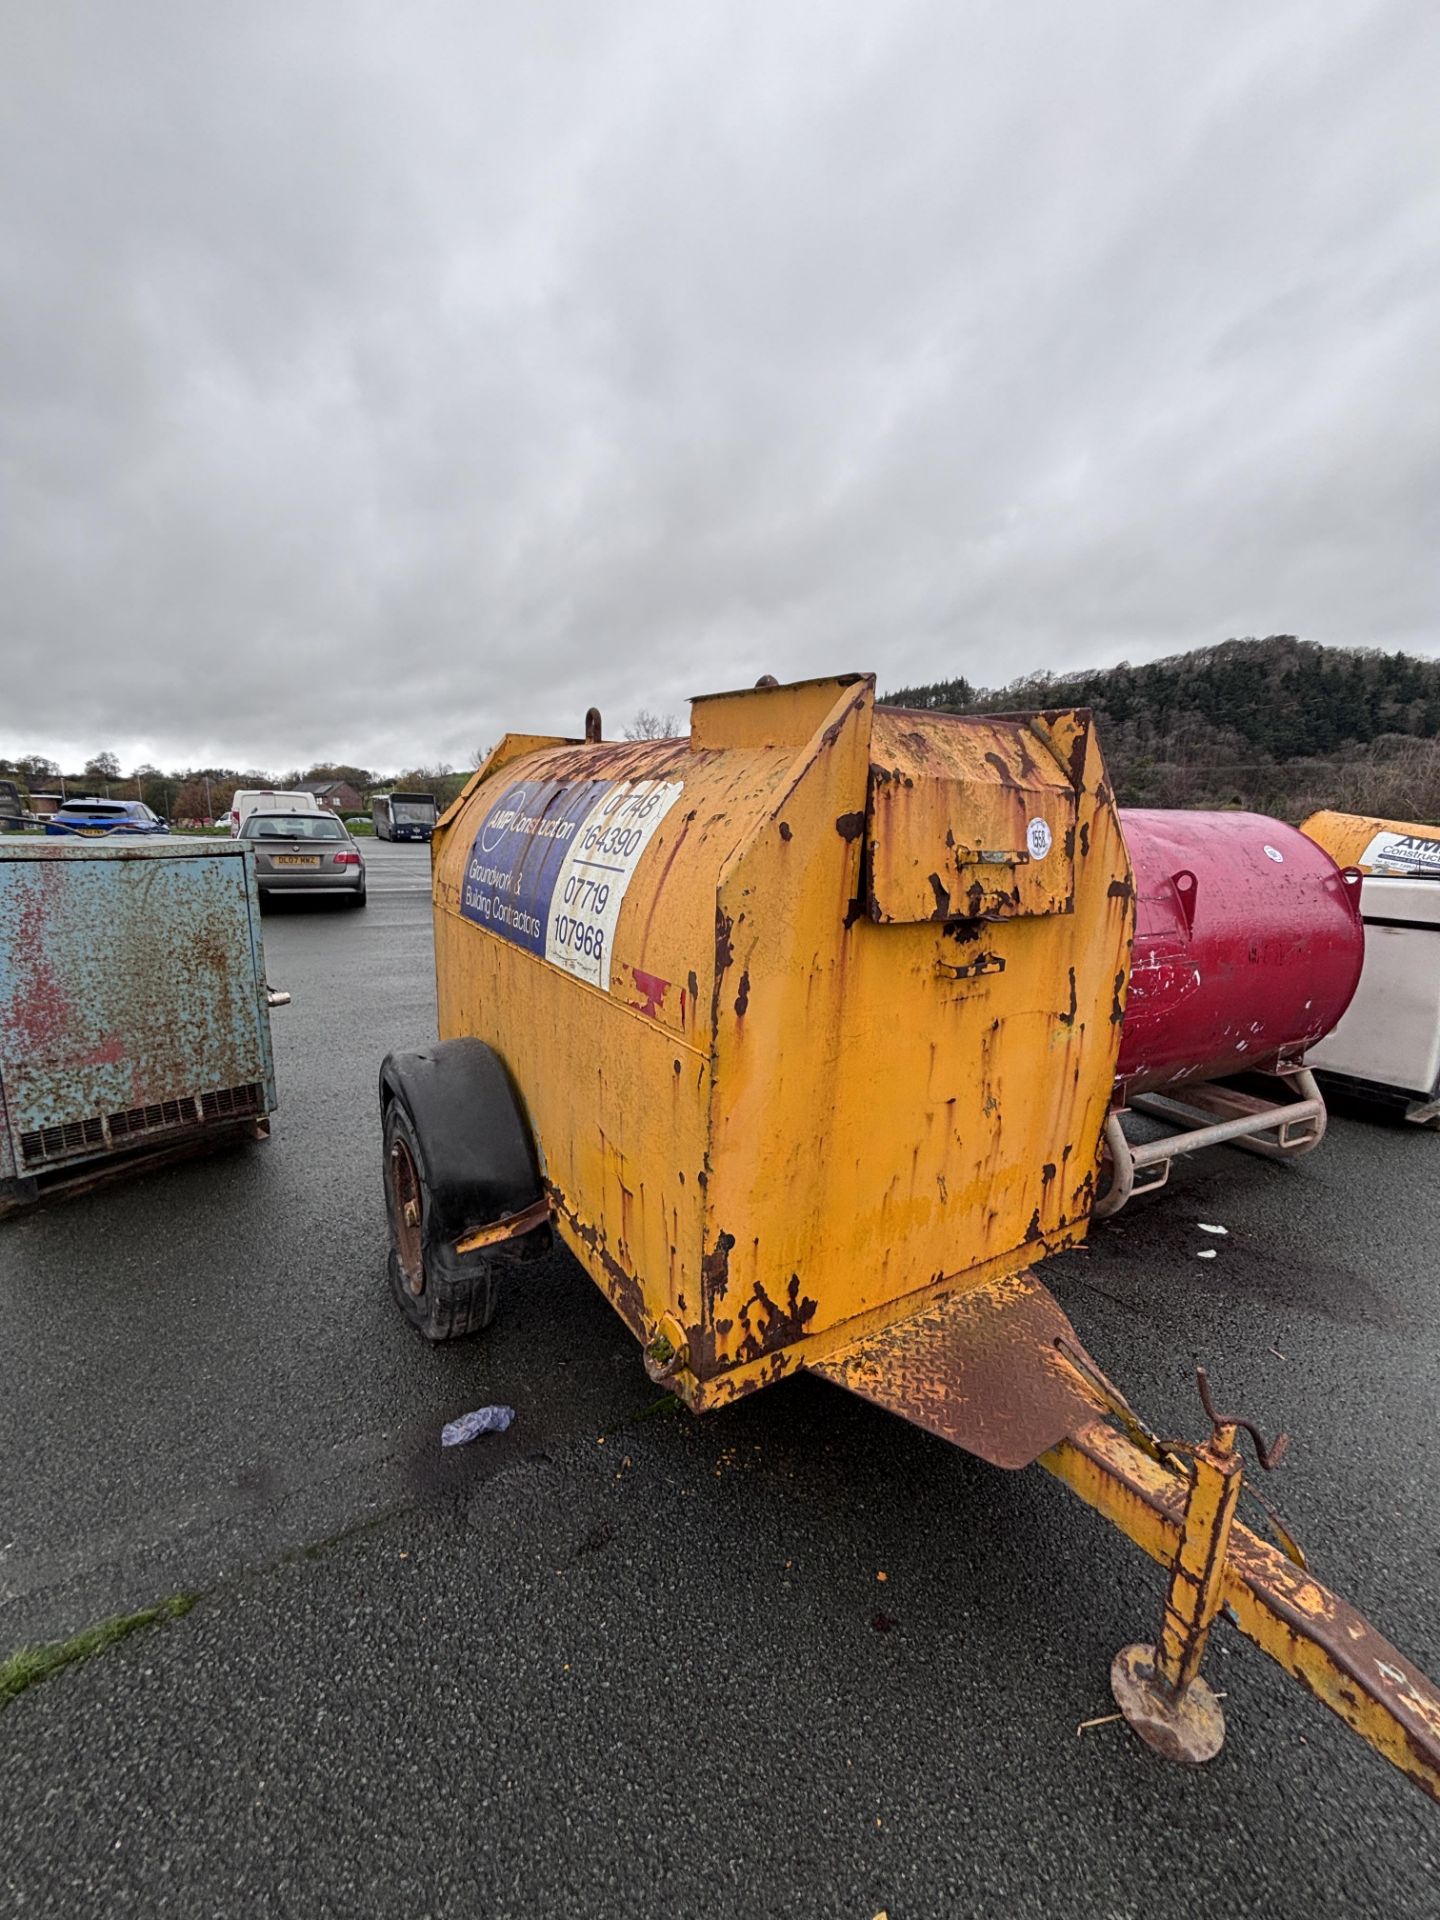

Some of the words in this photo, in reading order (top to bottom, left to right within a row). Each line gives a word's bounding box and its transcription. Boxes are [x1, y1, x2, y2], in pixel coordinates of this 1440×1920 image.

[603, 793, 661, 819] 07748
[509, 811, 576, 840] Constructon
[579, 824, 643, 858] 164390
[1393, 836, 1440, 855] AM
[469, 858, 513, 892] Groundwork
[513, 872, 523, 896] &
[465, 885, 491, 920] Building
[492, 896, 541, 938] Contractors
[564, 876, 610, 915] 07719
[555, 914, 604, 961] 107968
